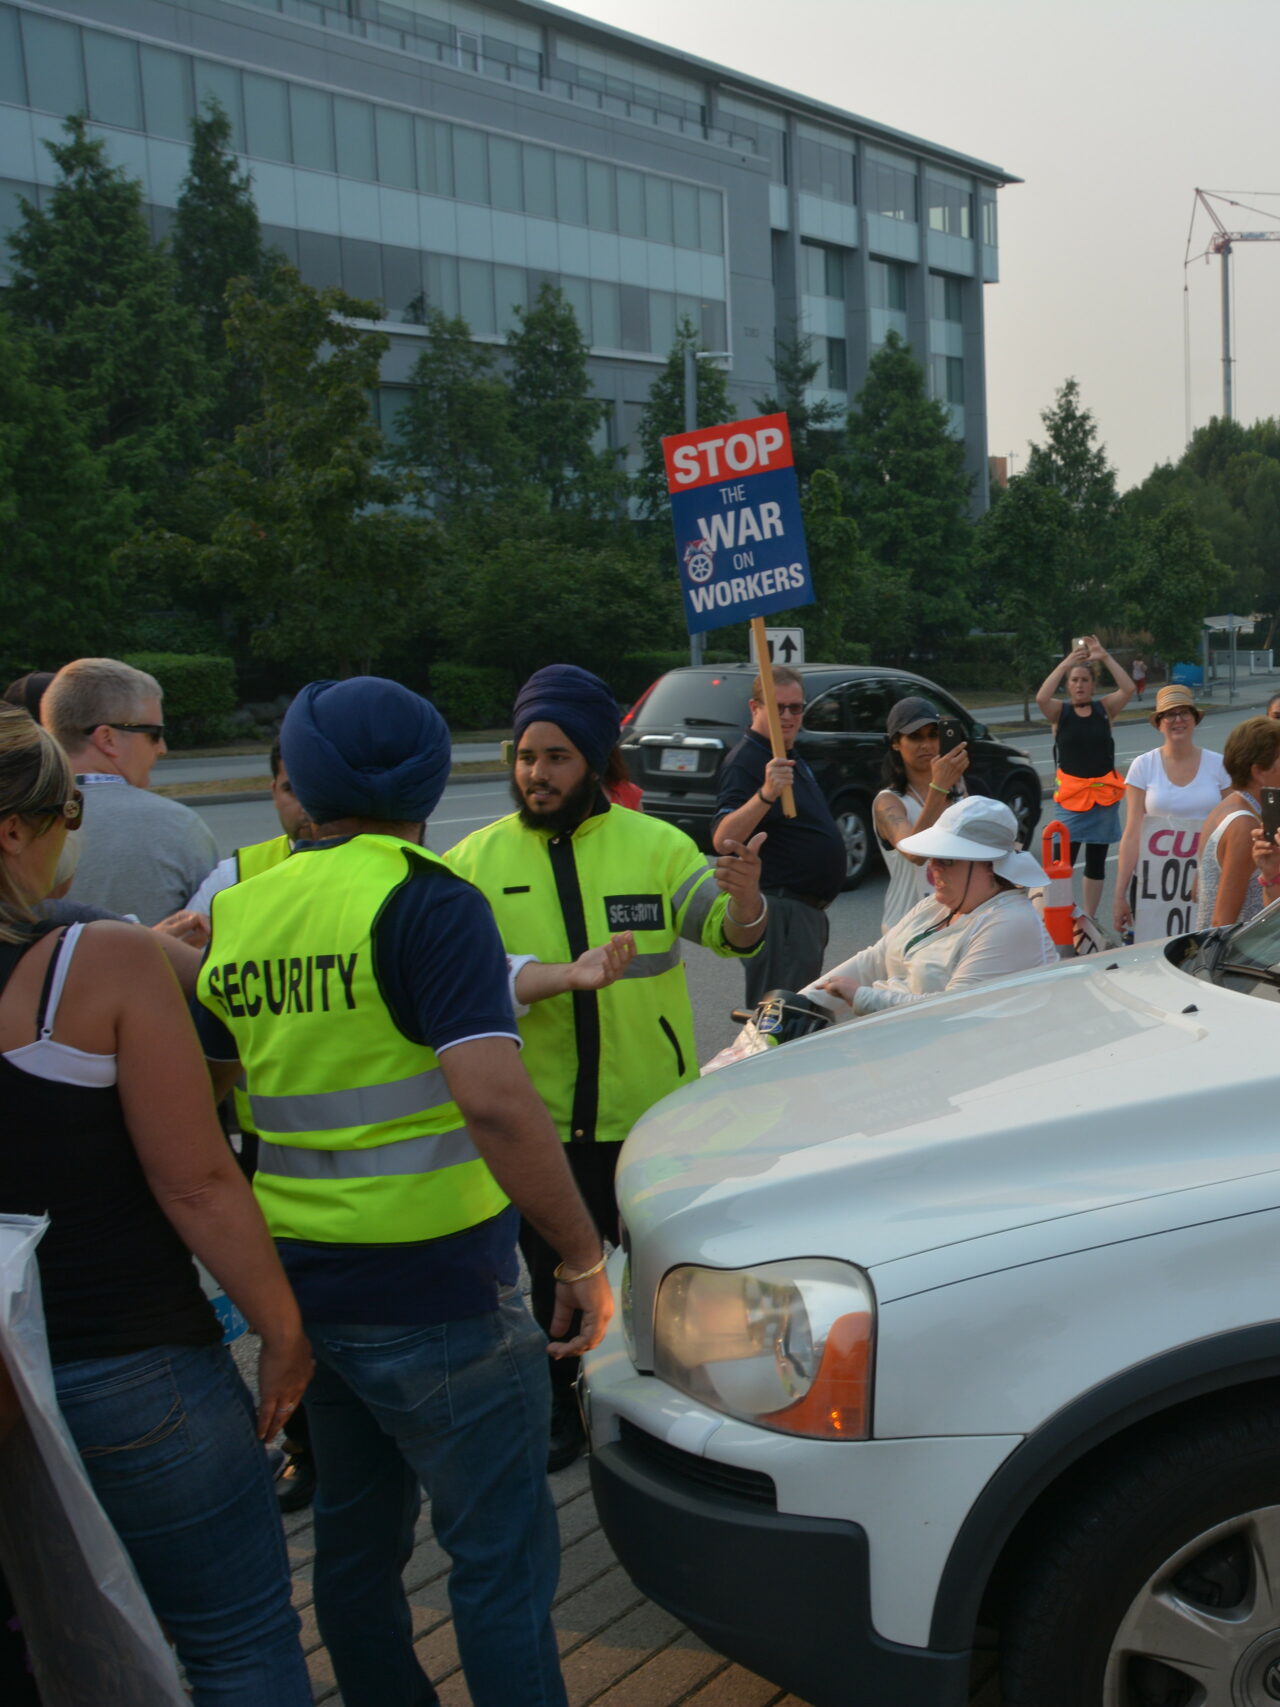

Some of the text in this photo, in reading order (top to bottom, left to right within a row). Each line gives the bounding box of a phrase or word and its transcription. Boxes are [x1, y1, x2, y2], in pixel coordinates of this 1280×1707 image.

[673, 428, 783, 484] STOP
[719, 484, 746, 505] THE
[697, 501, 784, 553] WAR
[733, 551, 754, 571] ON
[689, 562, 805, 613] WORKERS
[208, 953, 359, 1018] SECURITY
